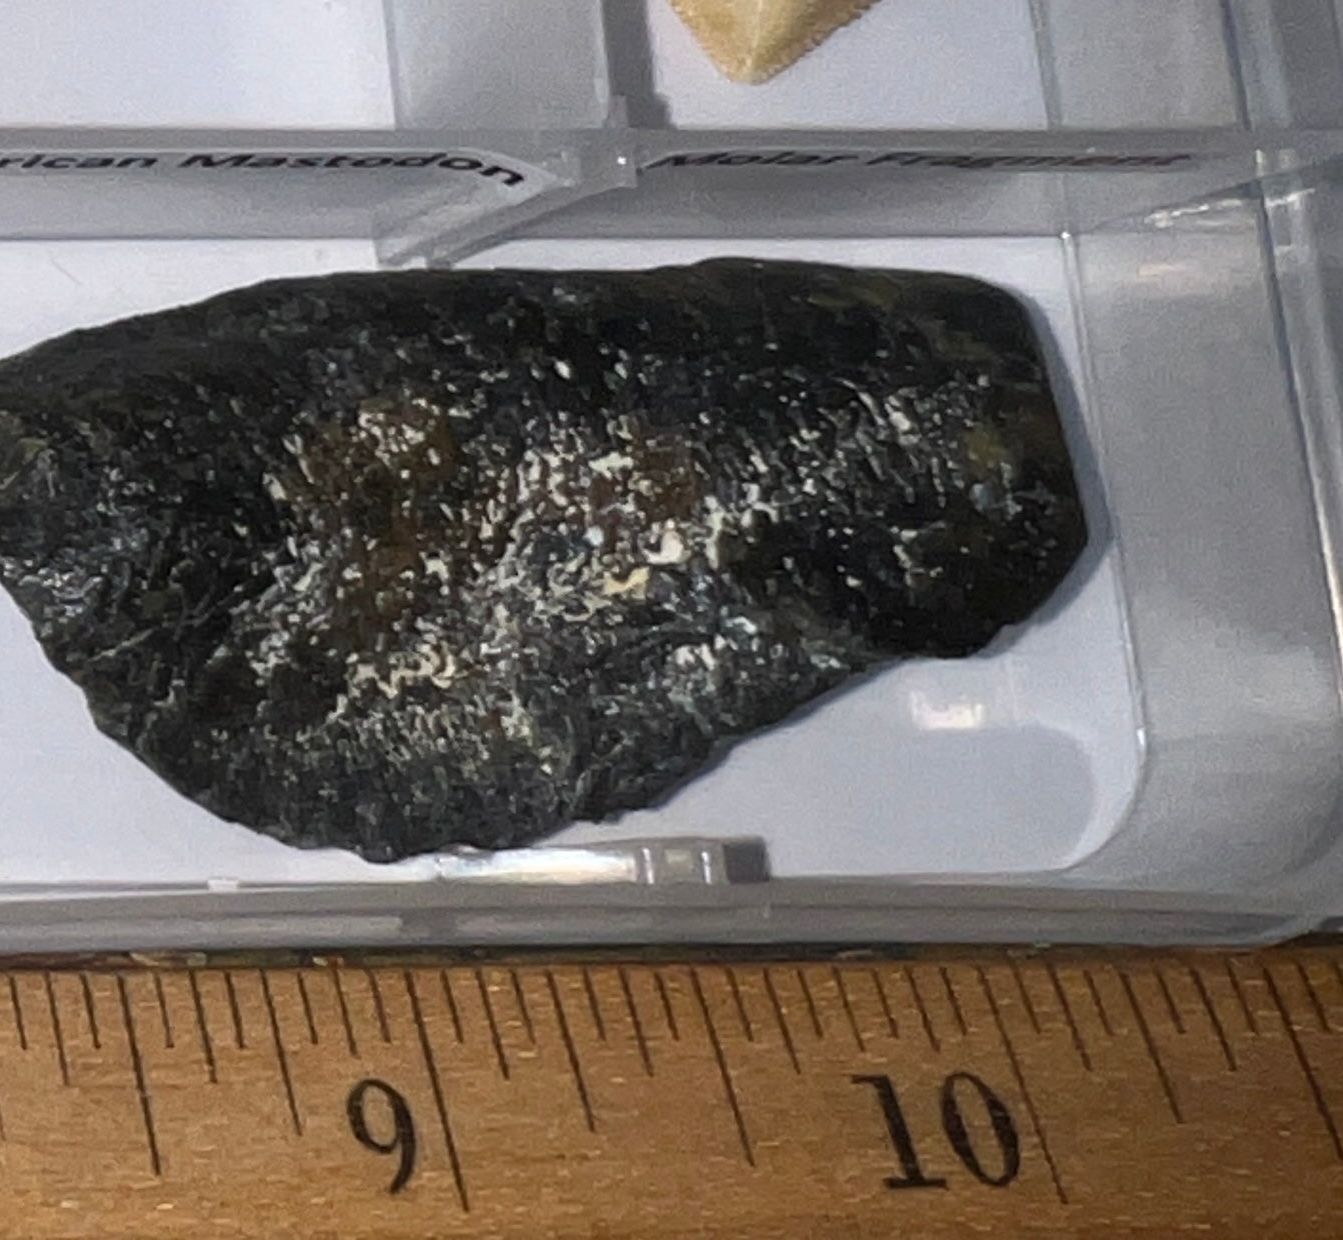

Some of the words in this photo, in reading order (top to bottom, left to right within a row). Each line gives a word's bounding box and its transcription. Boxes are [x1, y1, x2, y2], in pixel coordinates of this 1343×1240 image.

[177, 151, 526, 187] Mastodon
[345, 1077, 419, 1195] 9
[850, 1070, 1022, 1190] 10
